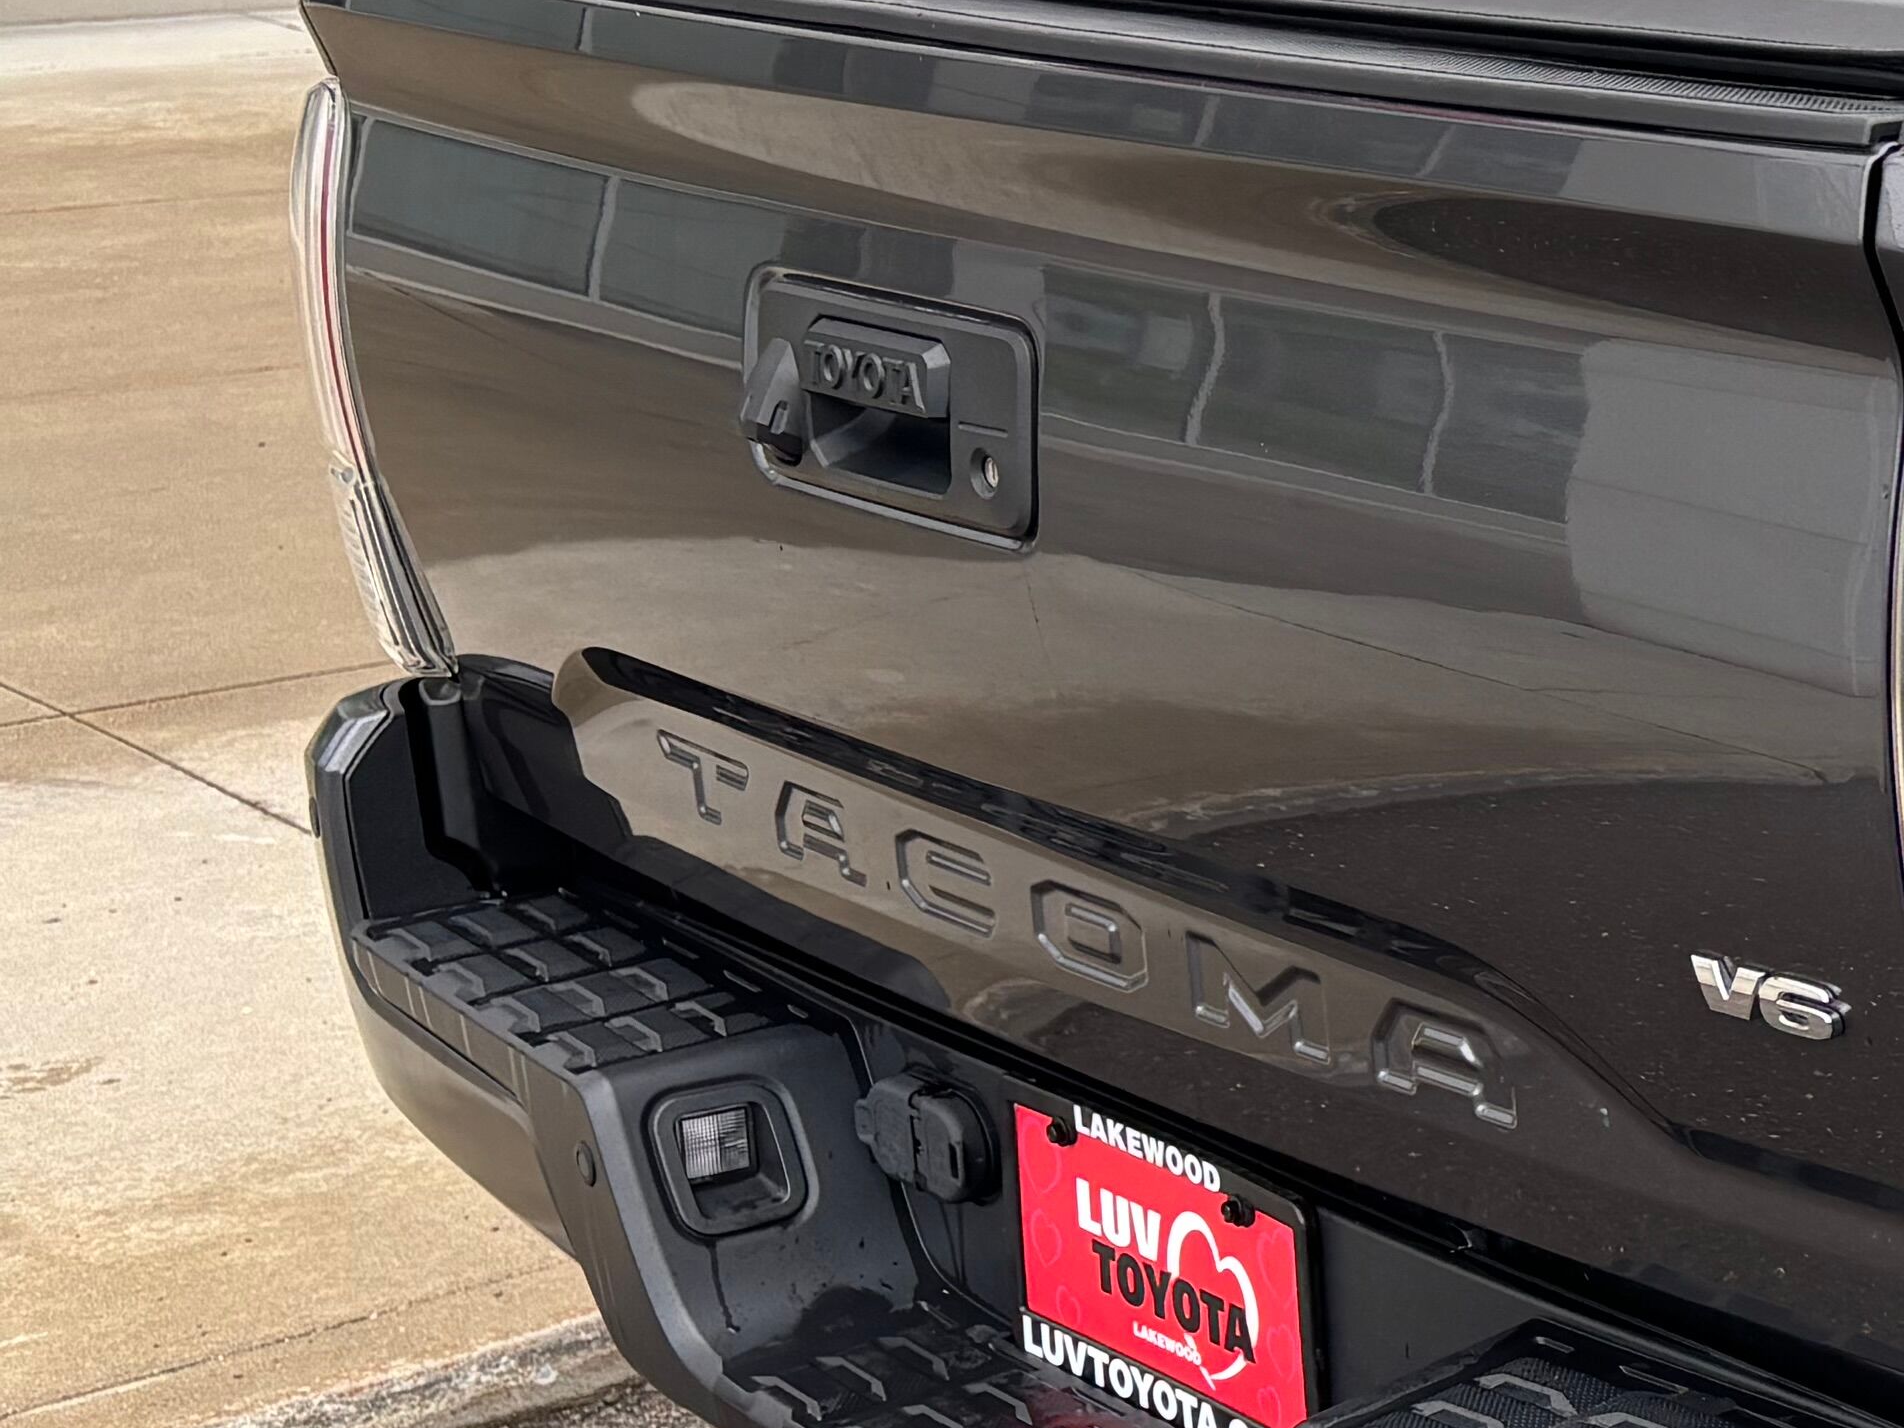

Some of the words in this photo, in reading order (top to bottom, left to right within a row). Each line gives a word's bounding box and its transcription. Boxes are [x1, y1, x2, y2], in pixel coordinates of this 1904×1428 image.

[803, 338, 928, 414] TOYOTA
[656, 727, 1518, 1129] TACOMA
[1690, 950, 1850, 1040] V6
[1073, 1104, 1222, 1193] LAKEWOOD
[1075, 1176, 1162, 1262] LUV
[1091, 1243, 1257, 1364] TOYOTA
[1132, 1320, 1202, 1368] LAKEWOOD
